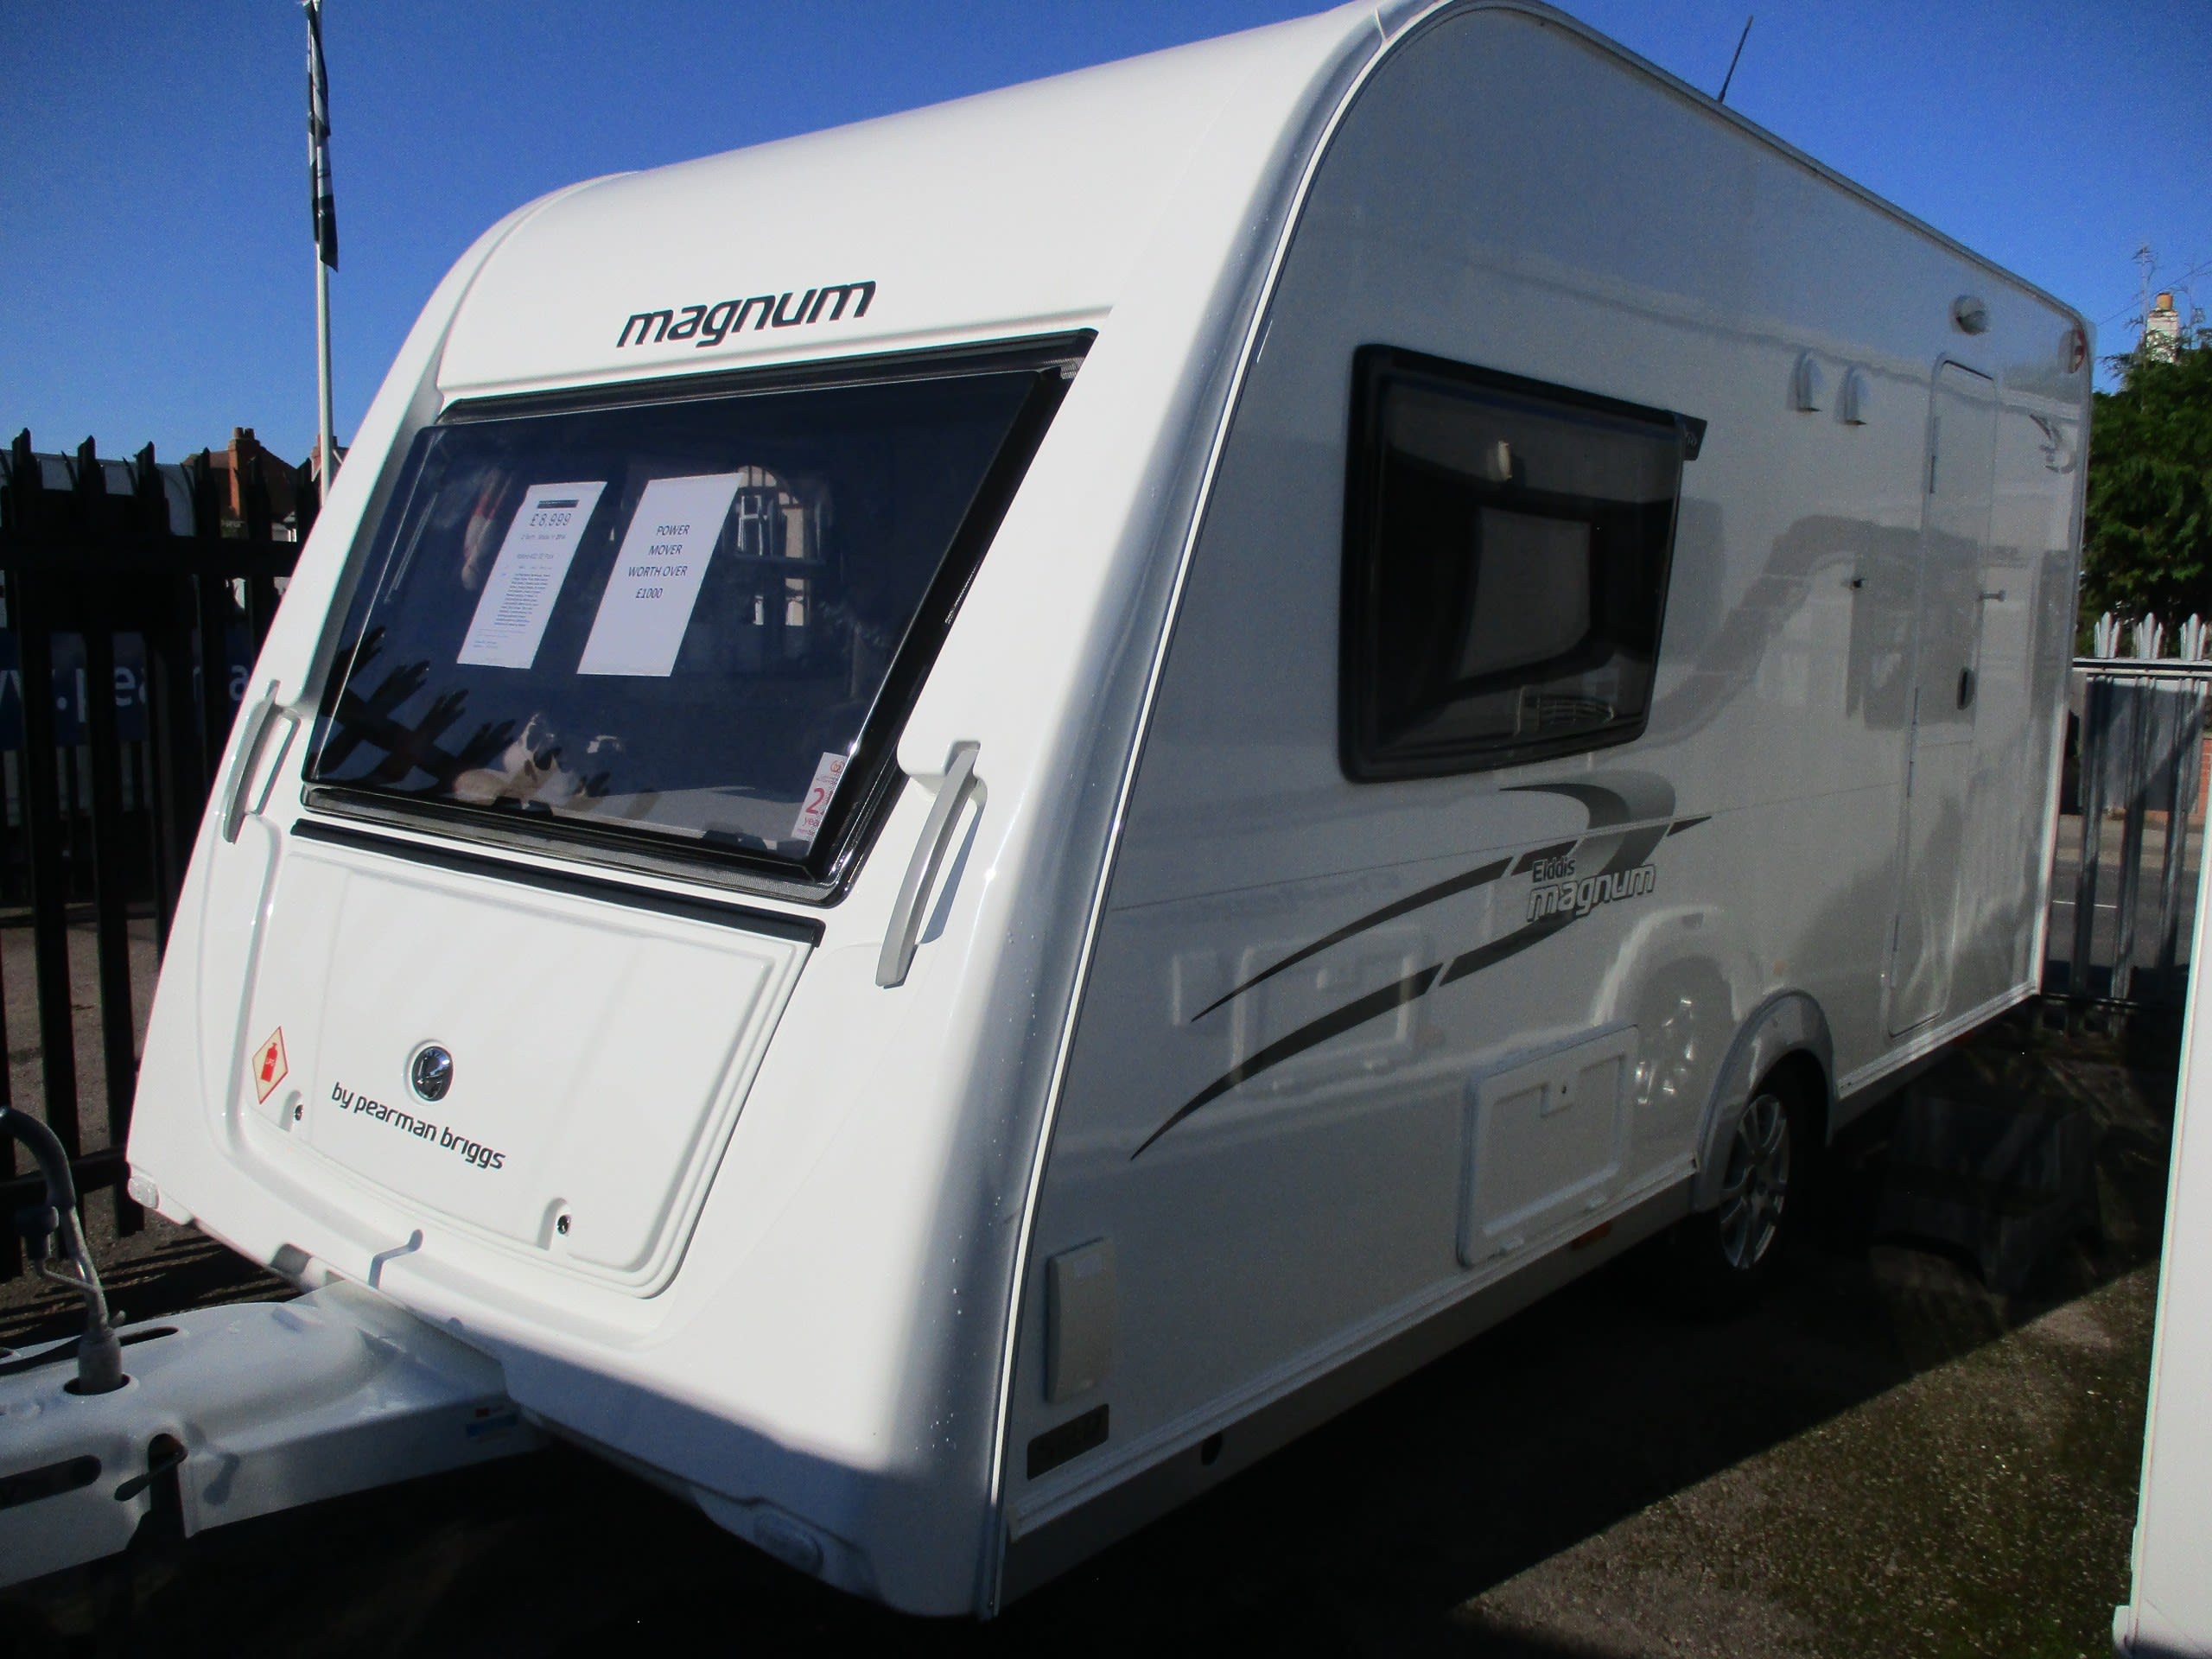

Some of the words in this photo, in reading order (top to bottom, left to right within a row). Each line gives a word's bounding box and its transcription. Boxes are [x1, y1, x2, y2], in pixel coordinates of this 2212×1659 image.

[616, 281, 876, 348] magnum
[530, 513, 572, 528] £8,999
[657, 524, 690, 536] POWER
[648, 544, 683, 556] MOVER
[628, 566, 661, 577] WORTH
[663, 565, 688, 576] OVER
[635, 588, 664, 599] £1000
[1533, 855, 1576, 883] Elddis
[1527, 864, 1656, 923] magnum
[332, 1082, 354, 1109] by
[353, 1096, 437, 1141] pearman
[439, 1127, 506, 1170] briggs
